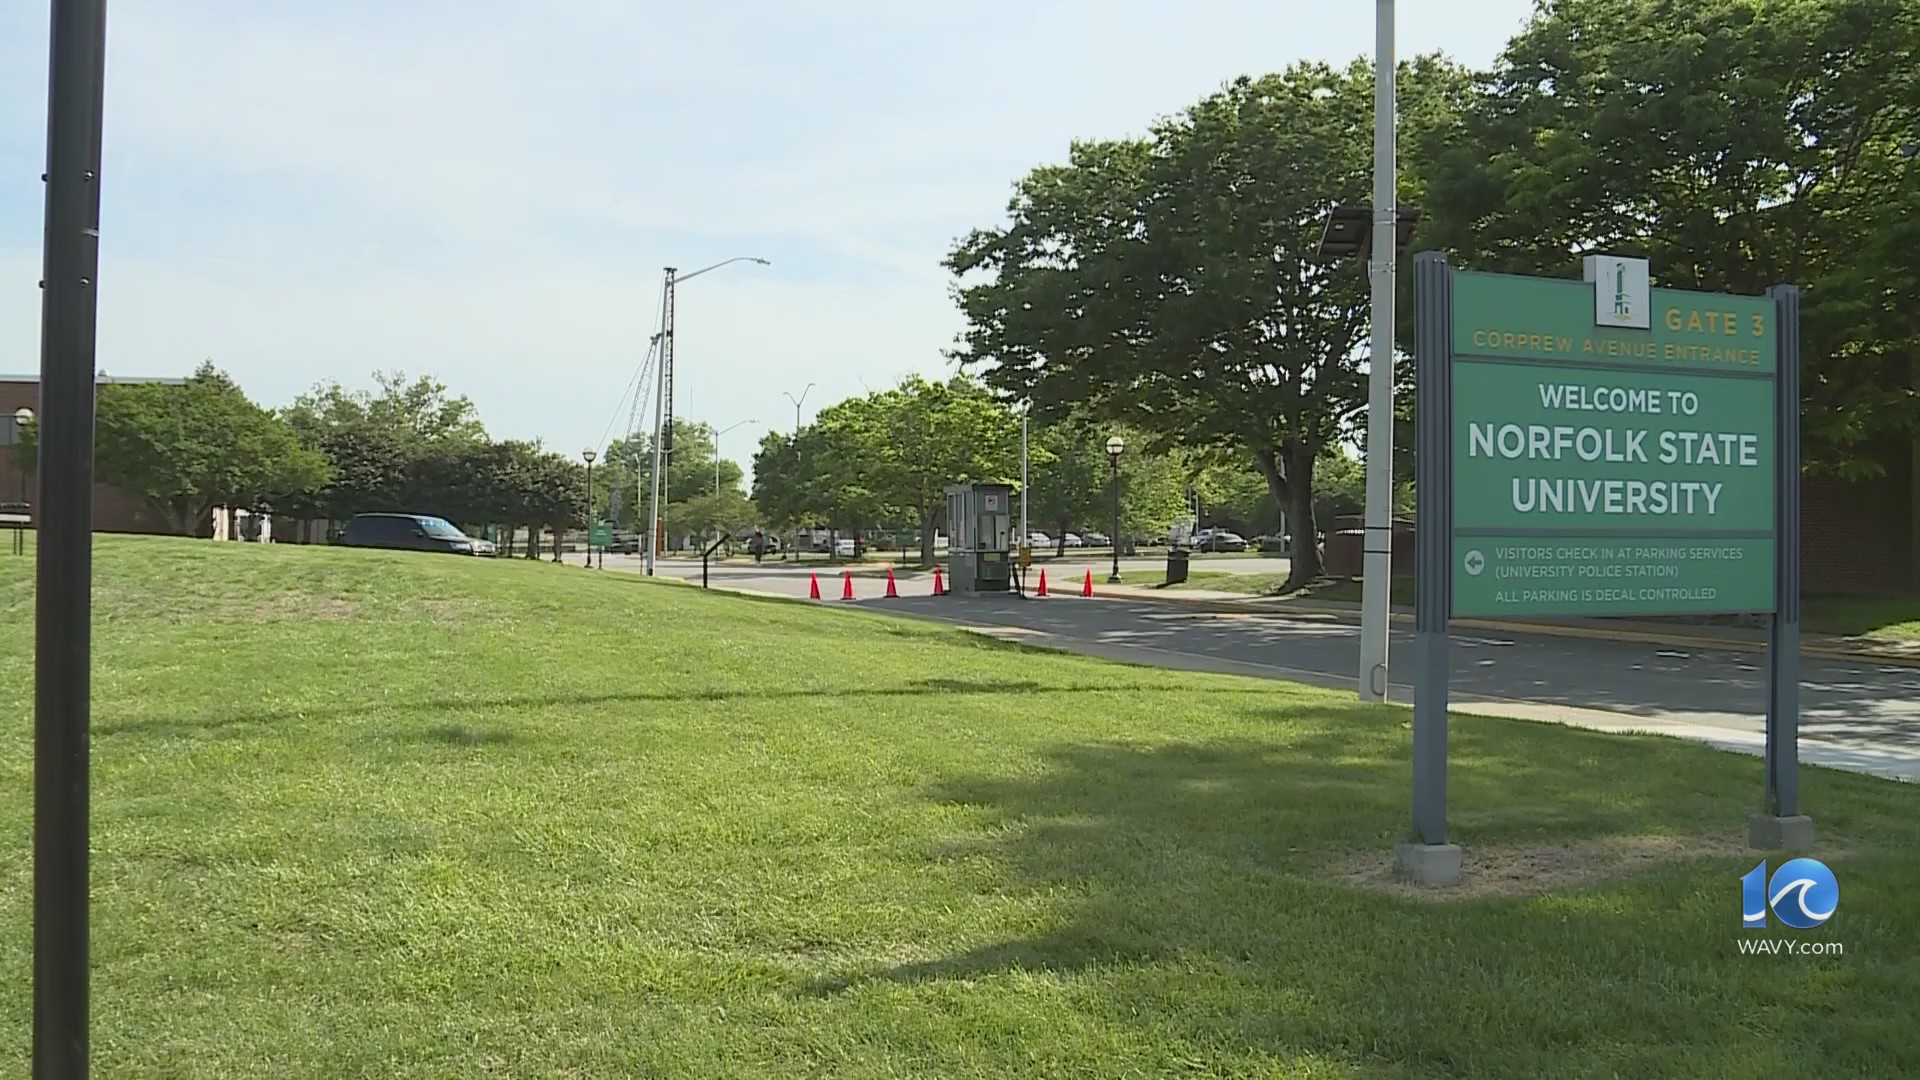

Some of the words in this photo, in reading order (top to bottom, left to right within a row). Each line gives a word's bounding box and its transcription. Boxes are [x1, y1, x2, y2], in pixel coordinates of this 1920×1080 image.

[1665, 308, 1737, 333] GATE
[1752, 314, 1764, 336] 3
[1474, 331, 1572, 352] CORPREW
[1582, 340, 1656, 359] AVENUE
[1664, 344, 1760, 365] ENTRANCE
[1539, 384, 1661, 413] WELCOME
[1668, 392, 1698, 414] TO
[1469, 424, 1647, 462] NORFOLK
[1659, 432, 1757, 466] STATE
[1513, 479, 1723, 514] UNIVERSITY
[1496, 548, 1553, 559] VISITORS
[1557, 548, 1598, 559] CHECK
[1601, 548, 1613, 559] IN
[1618, 548, 1632, 559] AT
[1636, 548, 1686, 559] PARKING
[1689, 547, 1743, 559] SERVICES
[1495, 564, 1575, 578] (UNIVERSITY
[1578, 566, 1621, 577] POLICE
[1625, 565, 1678, 578] STATION)
[1495, 590, 1519, 602] ALL
[1523, 589, 1578, 602] PARKING
[1581, 589, 1592, 601] IS
[1596, 589, 1636, 601] DECAL
[1639, 588, 1716, 600] CONTROLLED
